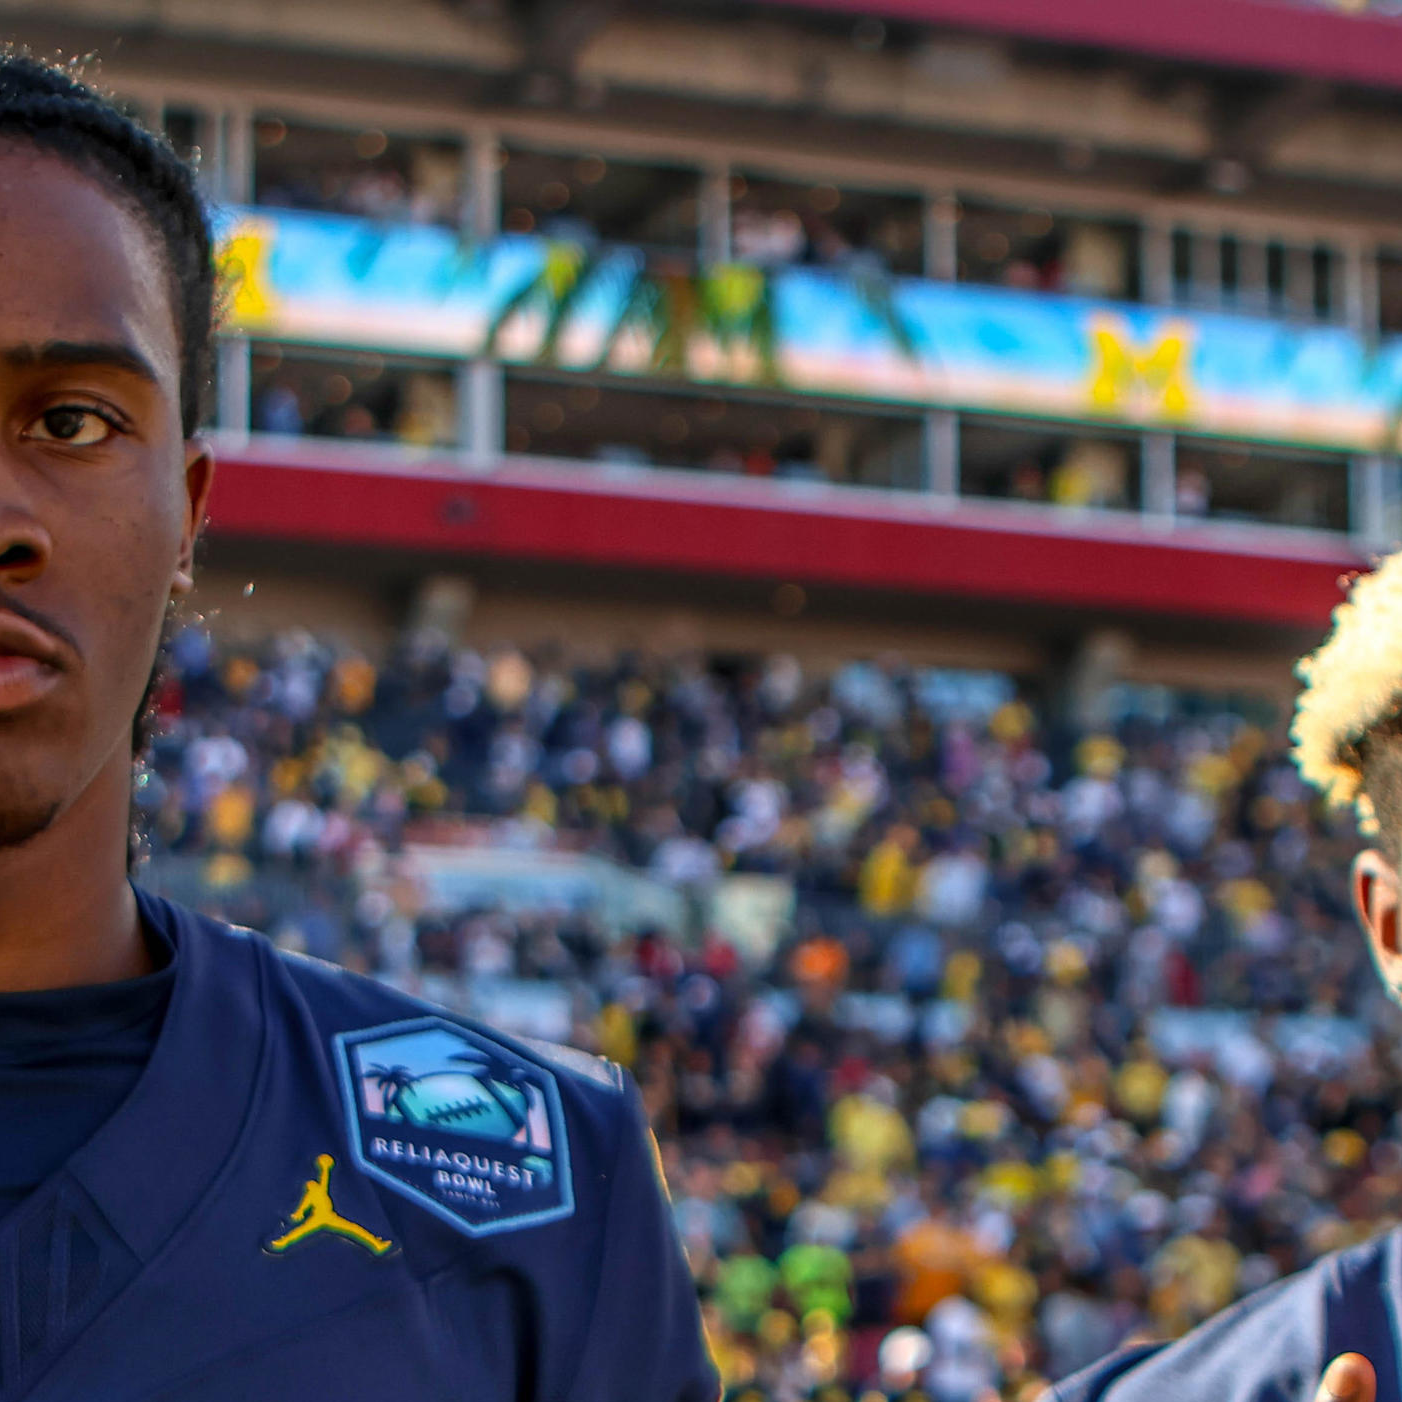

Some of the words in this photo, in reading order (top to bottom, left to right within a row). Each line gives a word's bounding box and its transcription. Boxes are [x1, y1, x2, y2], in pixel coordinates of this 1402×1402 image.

[1086, 311, 1198, 425] M
[372, 1137, 535, 1190] RELIAQUEST
[437, 1169, 496, 1195] BOWL
